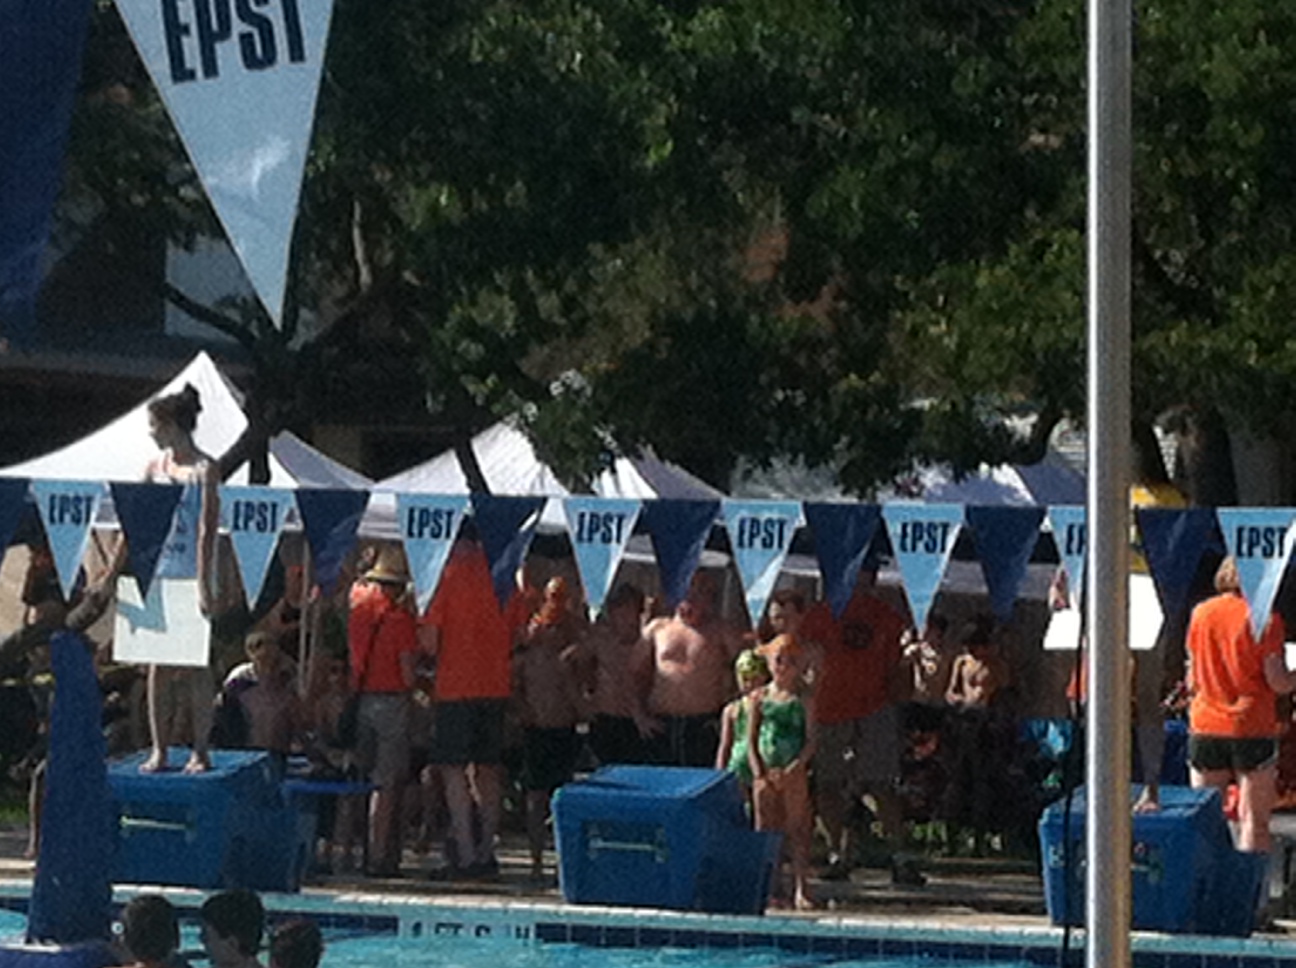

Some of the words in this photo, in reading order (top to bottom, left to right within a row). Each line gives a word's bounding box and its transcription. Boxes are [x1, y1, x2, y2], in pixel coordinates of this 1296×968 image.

[49, 495, 93, 526] EPST
[233, 500, 279, 533] EPST
[407, 507, 455, 539] EPST
[577, 511, 626, 544] EPST
[738, 517, 788, 549] EPST
[900, 522, 951, 555] EPST
[1236, 525, 1288, 558] EPST
